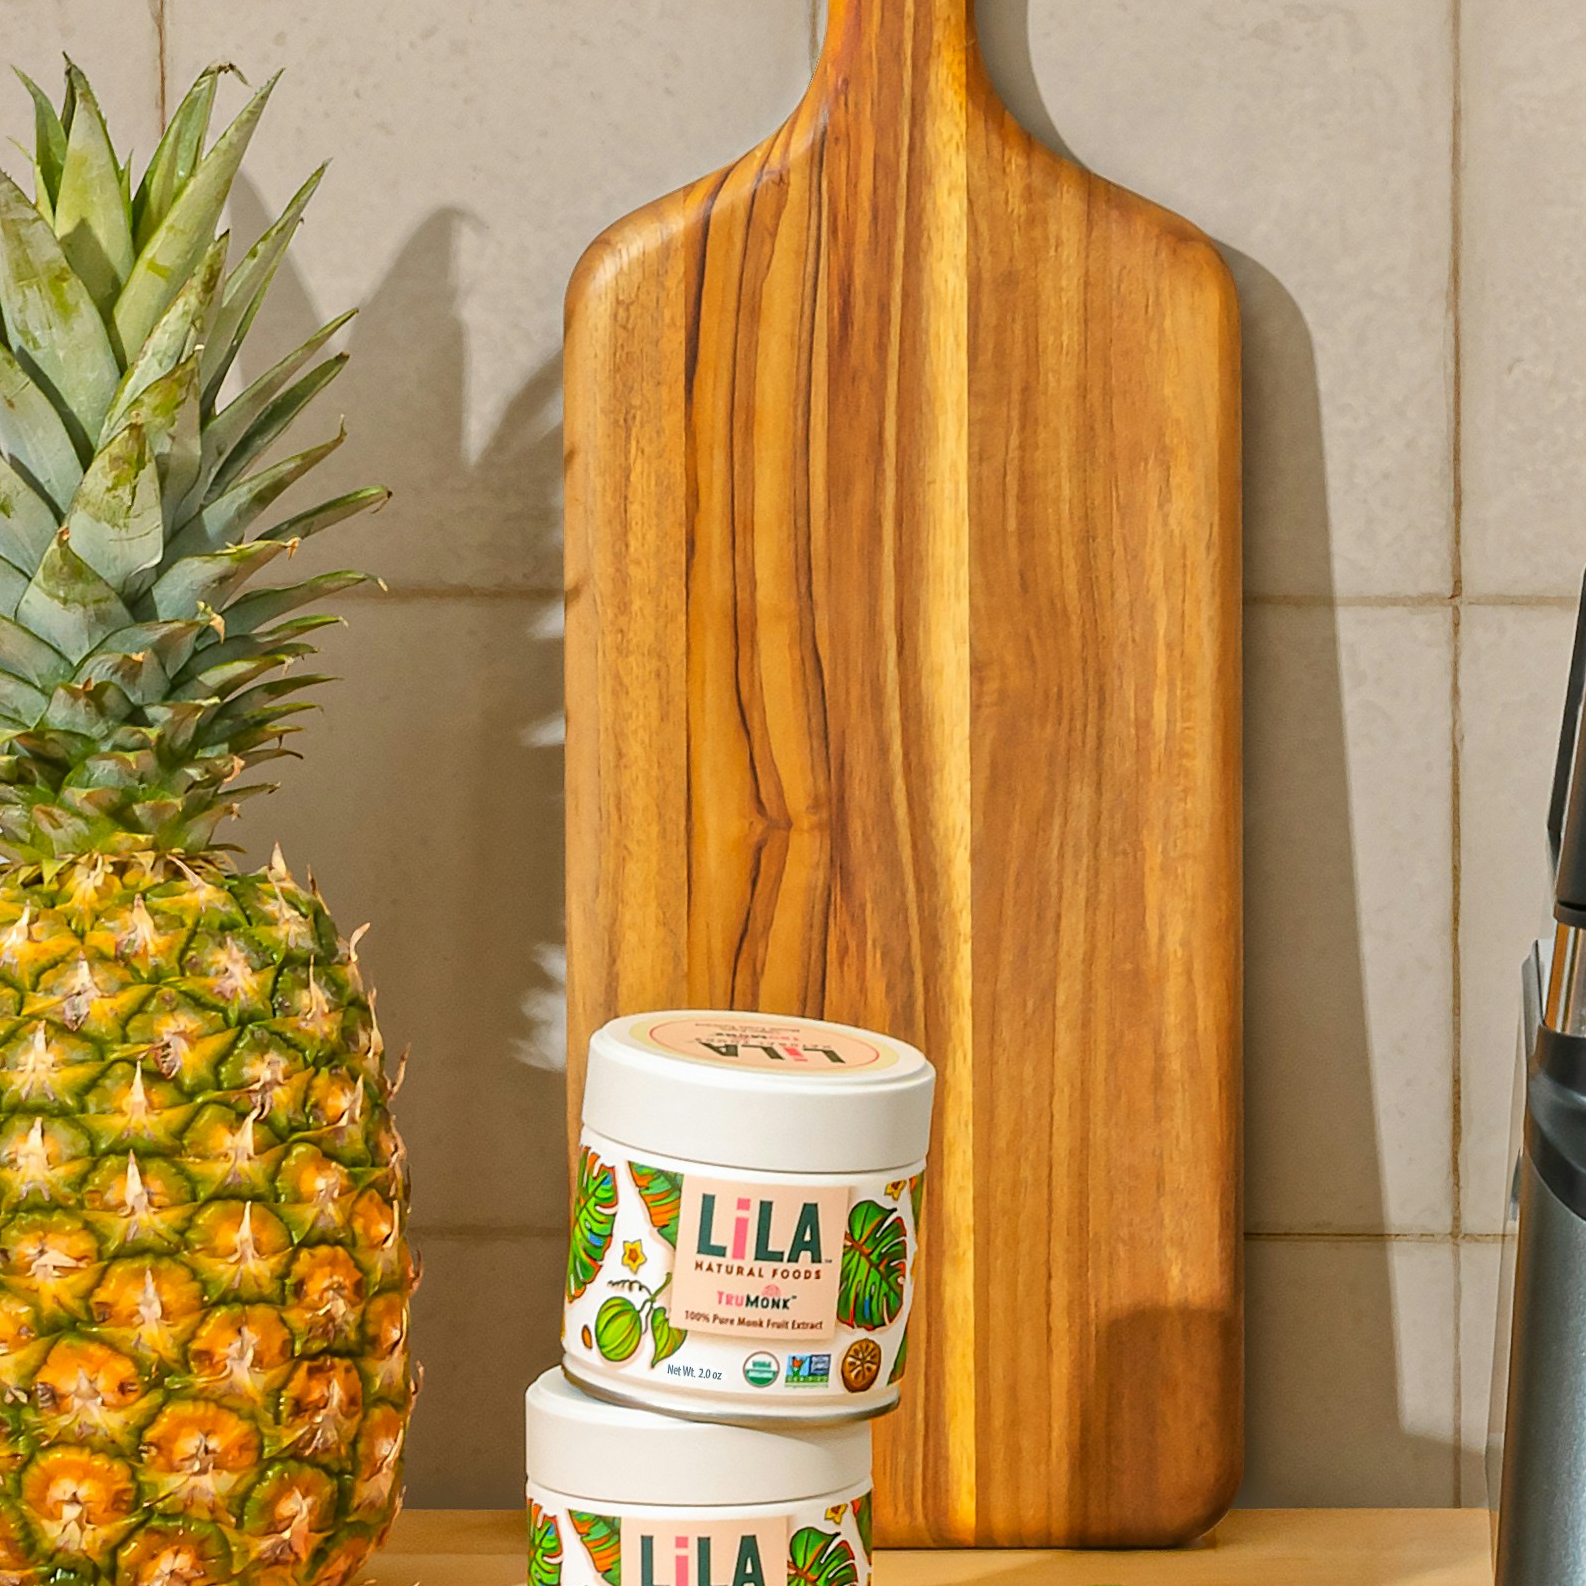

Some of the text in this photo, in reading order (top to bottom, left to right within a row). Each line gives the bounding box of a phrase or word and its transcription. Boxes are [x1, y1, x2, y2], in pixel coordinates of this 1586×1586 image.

[694, 1260, 821, 1280] NATURAL FOODS
[685, 1310, 823, 1331] 100% Pure Monk Fruit Extract
[667, 1364, 722, 1380] Net Wt. 2.0 oz
